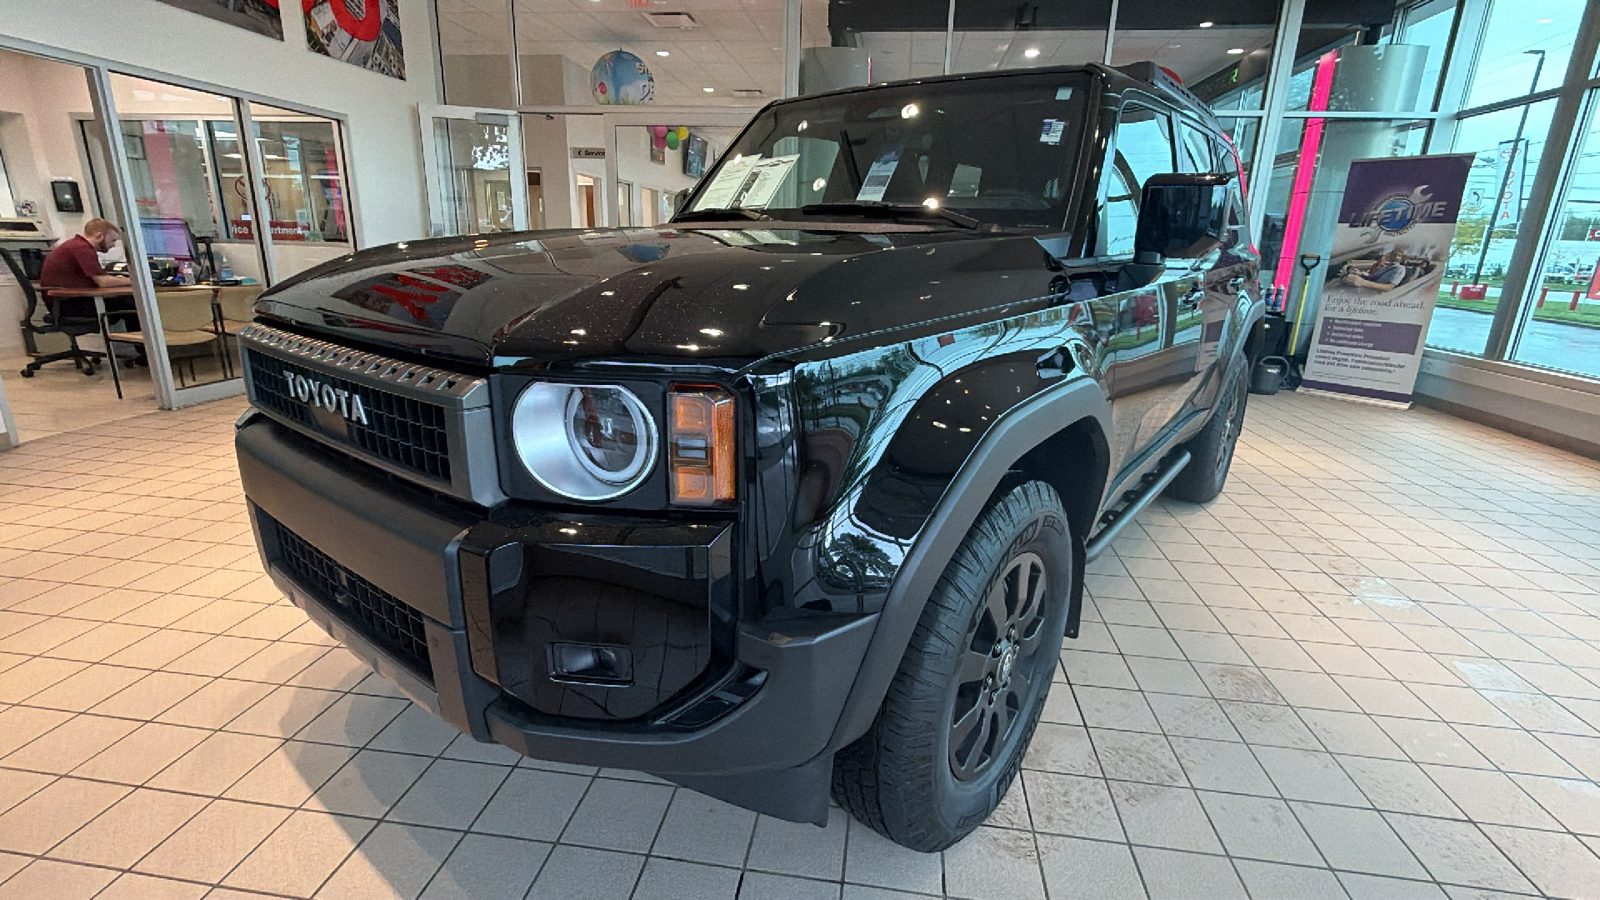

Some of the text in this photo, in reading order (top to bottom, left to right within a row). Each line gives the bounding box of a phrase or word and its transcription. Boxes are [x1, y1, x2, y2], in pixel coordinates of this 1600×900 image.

[1349, 202, 1448, 228] LIFETIME
[1324, 303, 1336, 312] for
[1346, 305, 1378, 315] lifetime.
[1327, 294, 1426, 310] Enjoy the road ahead.
[283, 369, 368, 425] TOYOTA
